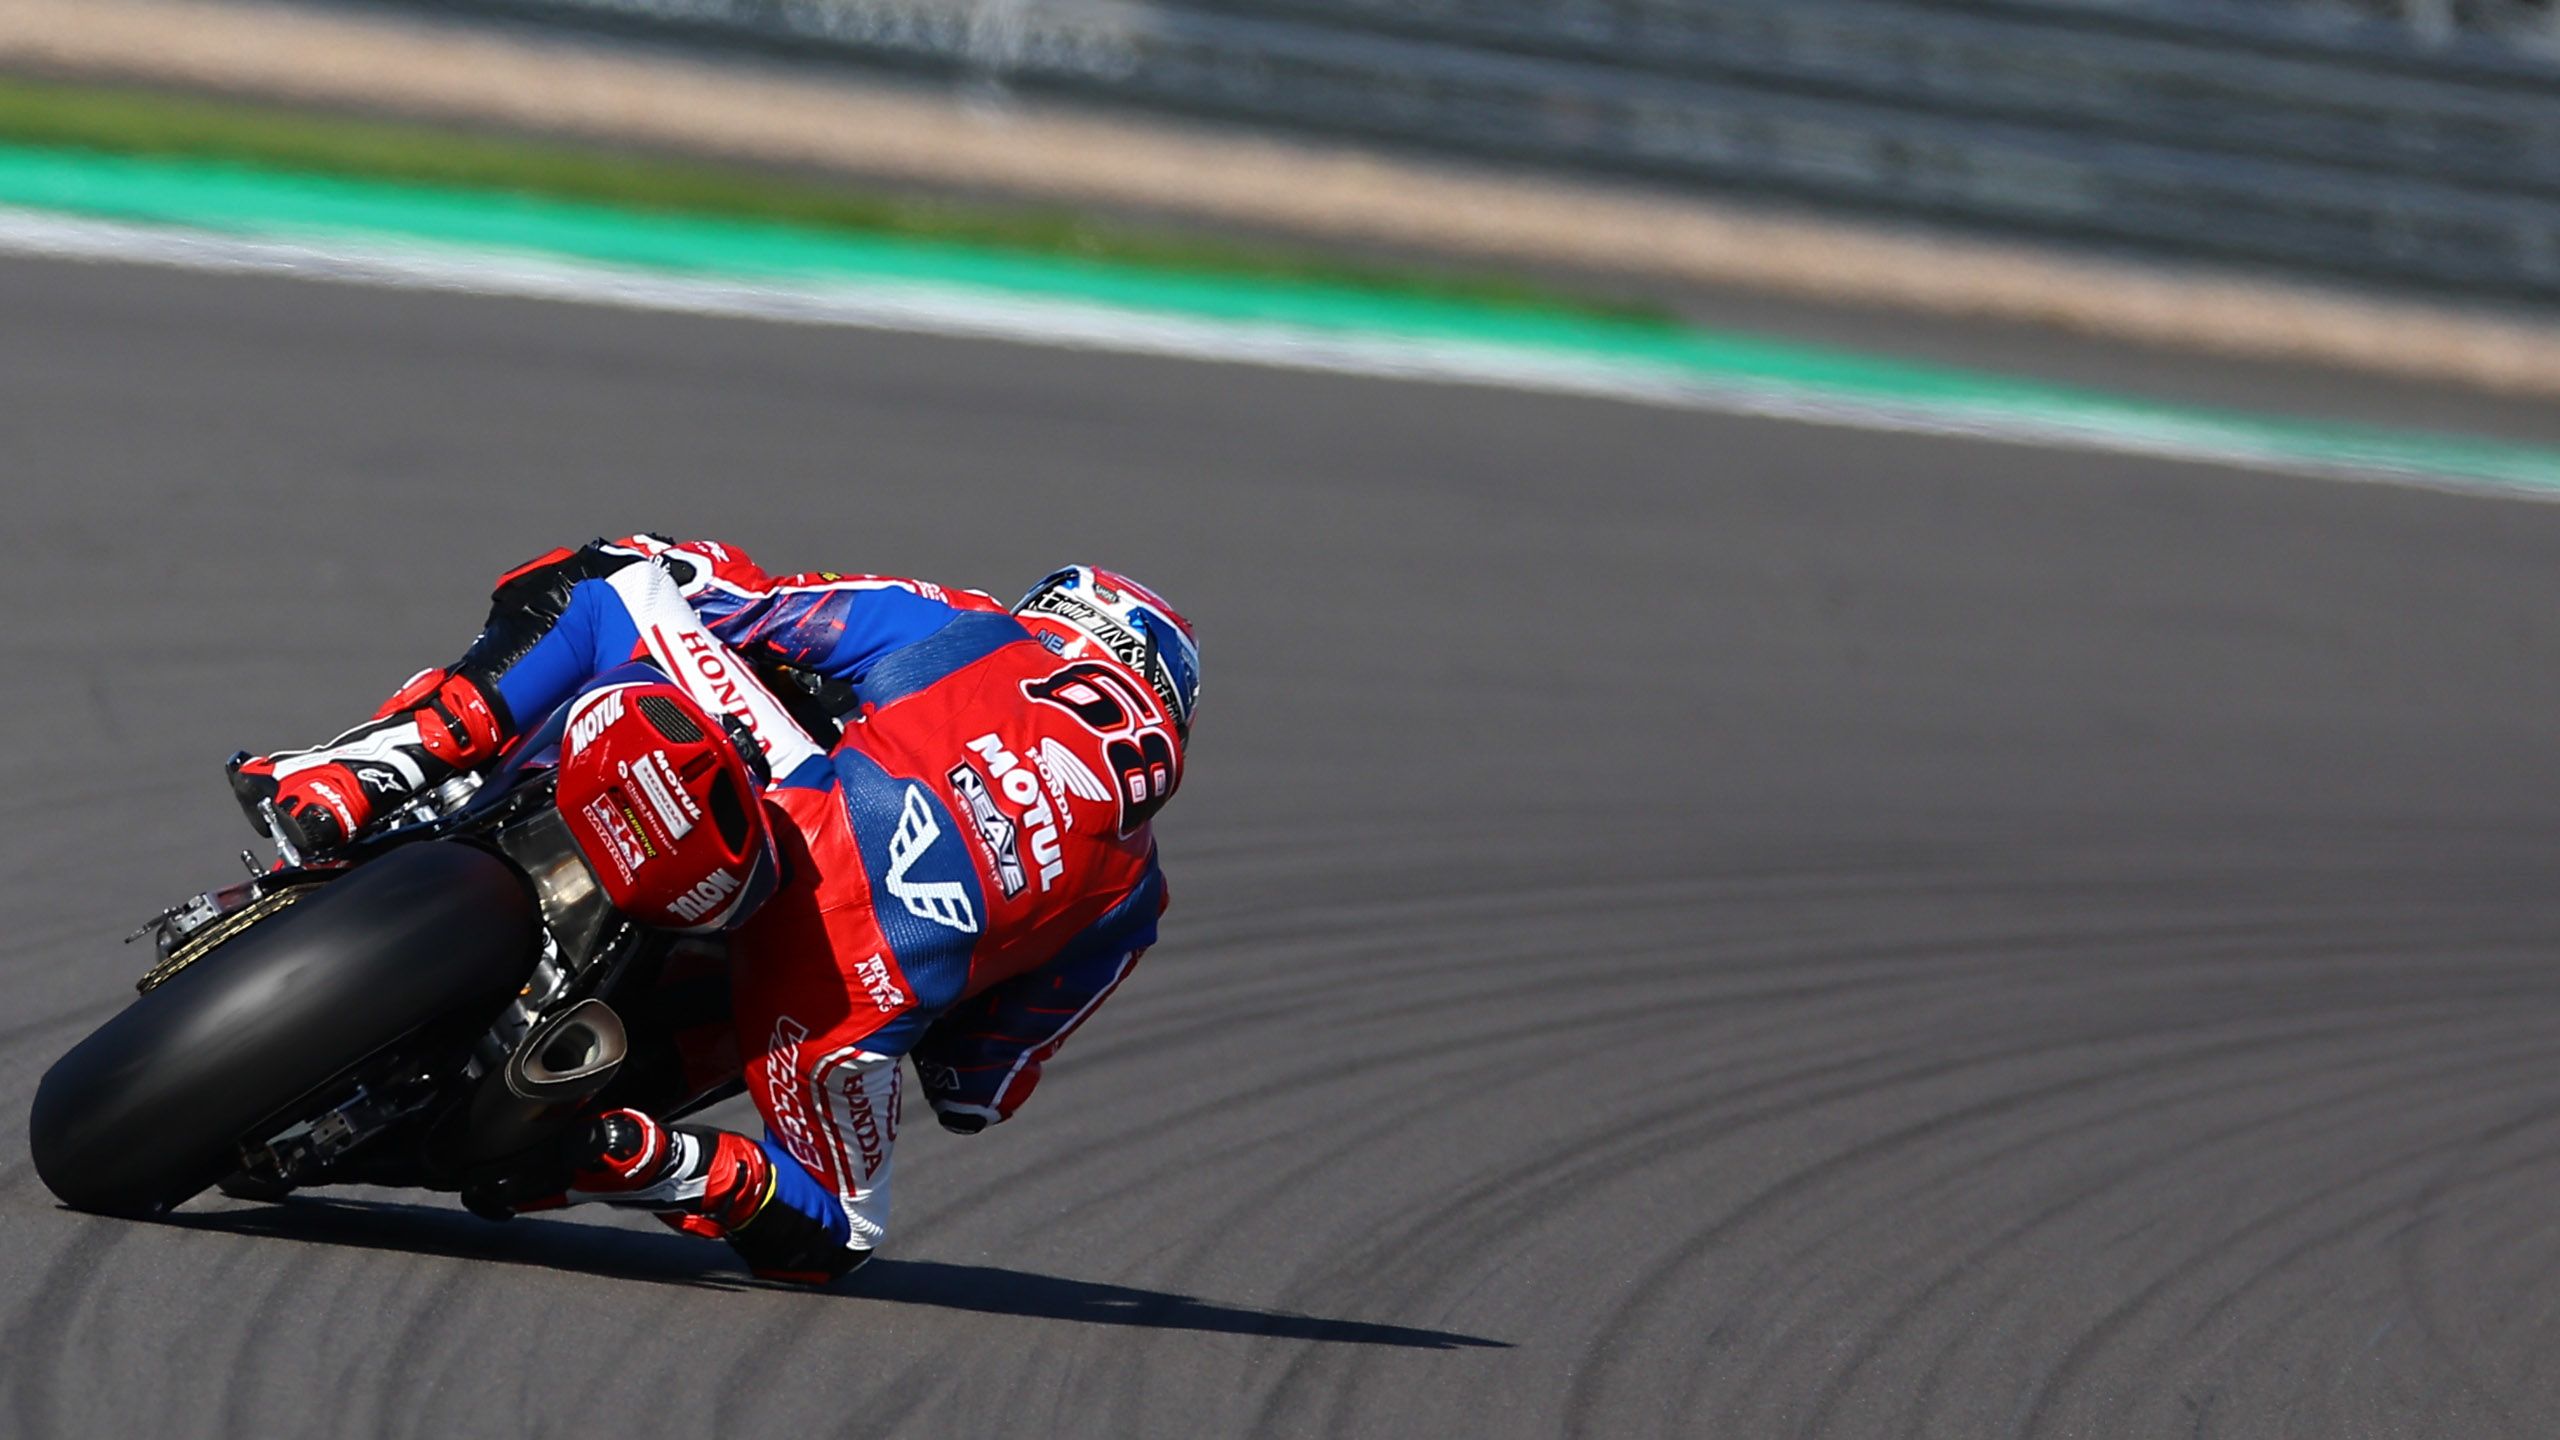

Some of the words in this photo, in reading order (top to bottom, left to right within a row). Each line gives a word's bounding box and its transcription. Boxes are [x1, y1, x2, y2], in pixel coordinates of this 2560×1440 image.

[571, 689, 625, 756] MOTUL
[1019, 659, 1181, 841] 68
[653, 749, 702, 820] MOTUL
[965, 732, 1064, 893] MOTUL
[1025, 746, 1074, 833] HONDA
[597, 796, 643, 867] RK
[952, 766, 1026, 897] NEAVE
[666, 867, 741, 922] MOTUL
[842, 1072, 883, 1182] HONDA
